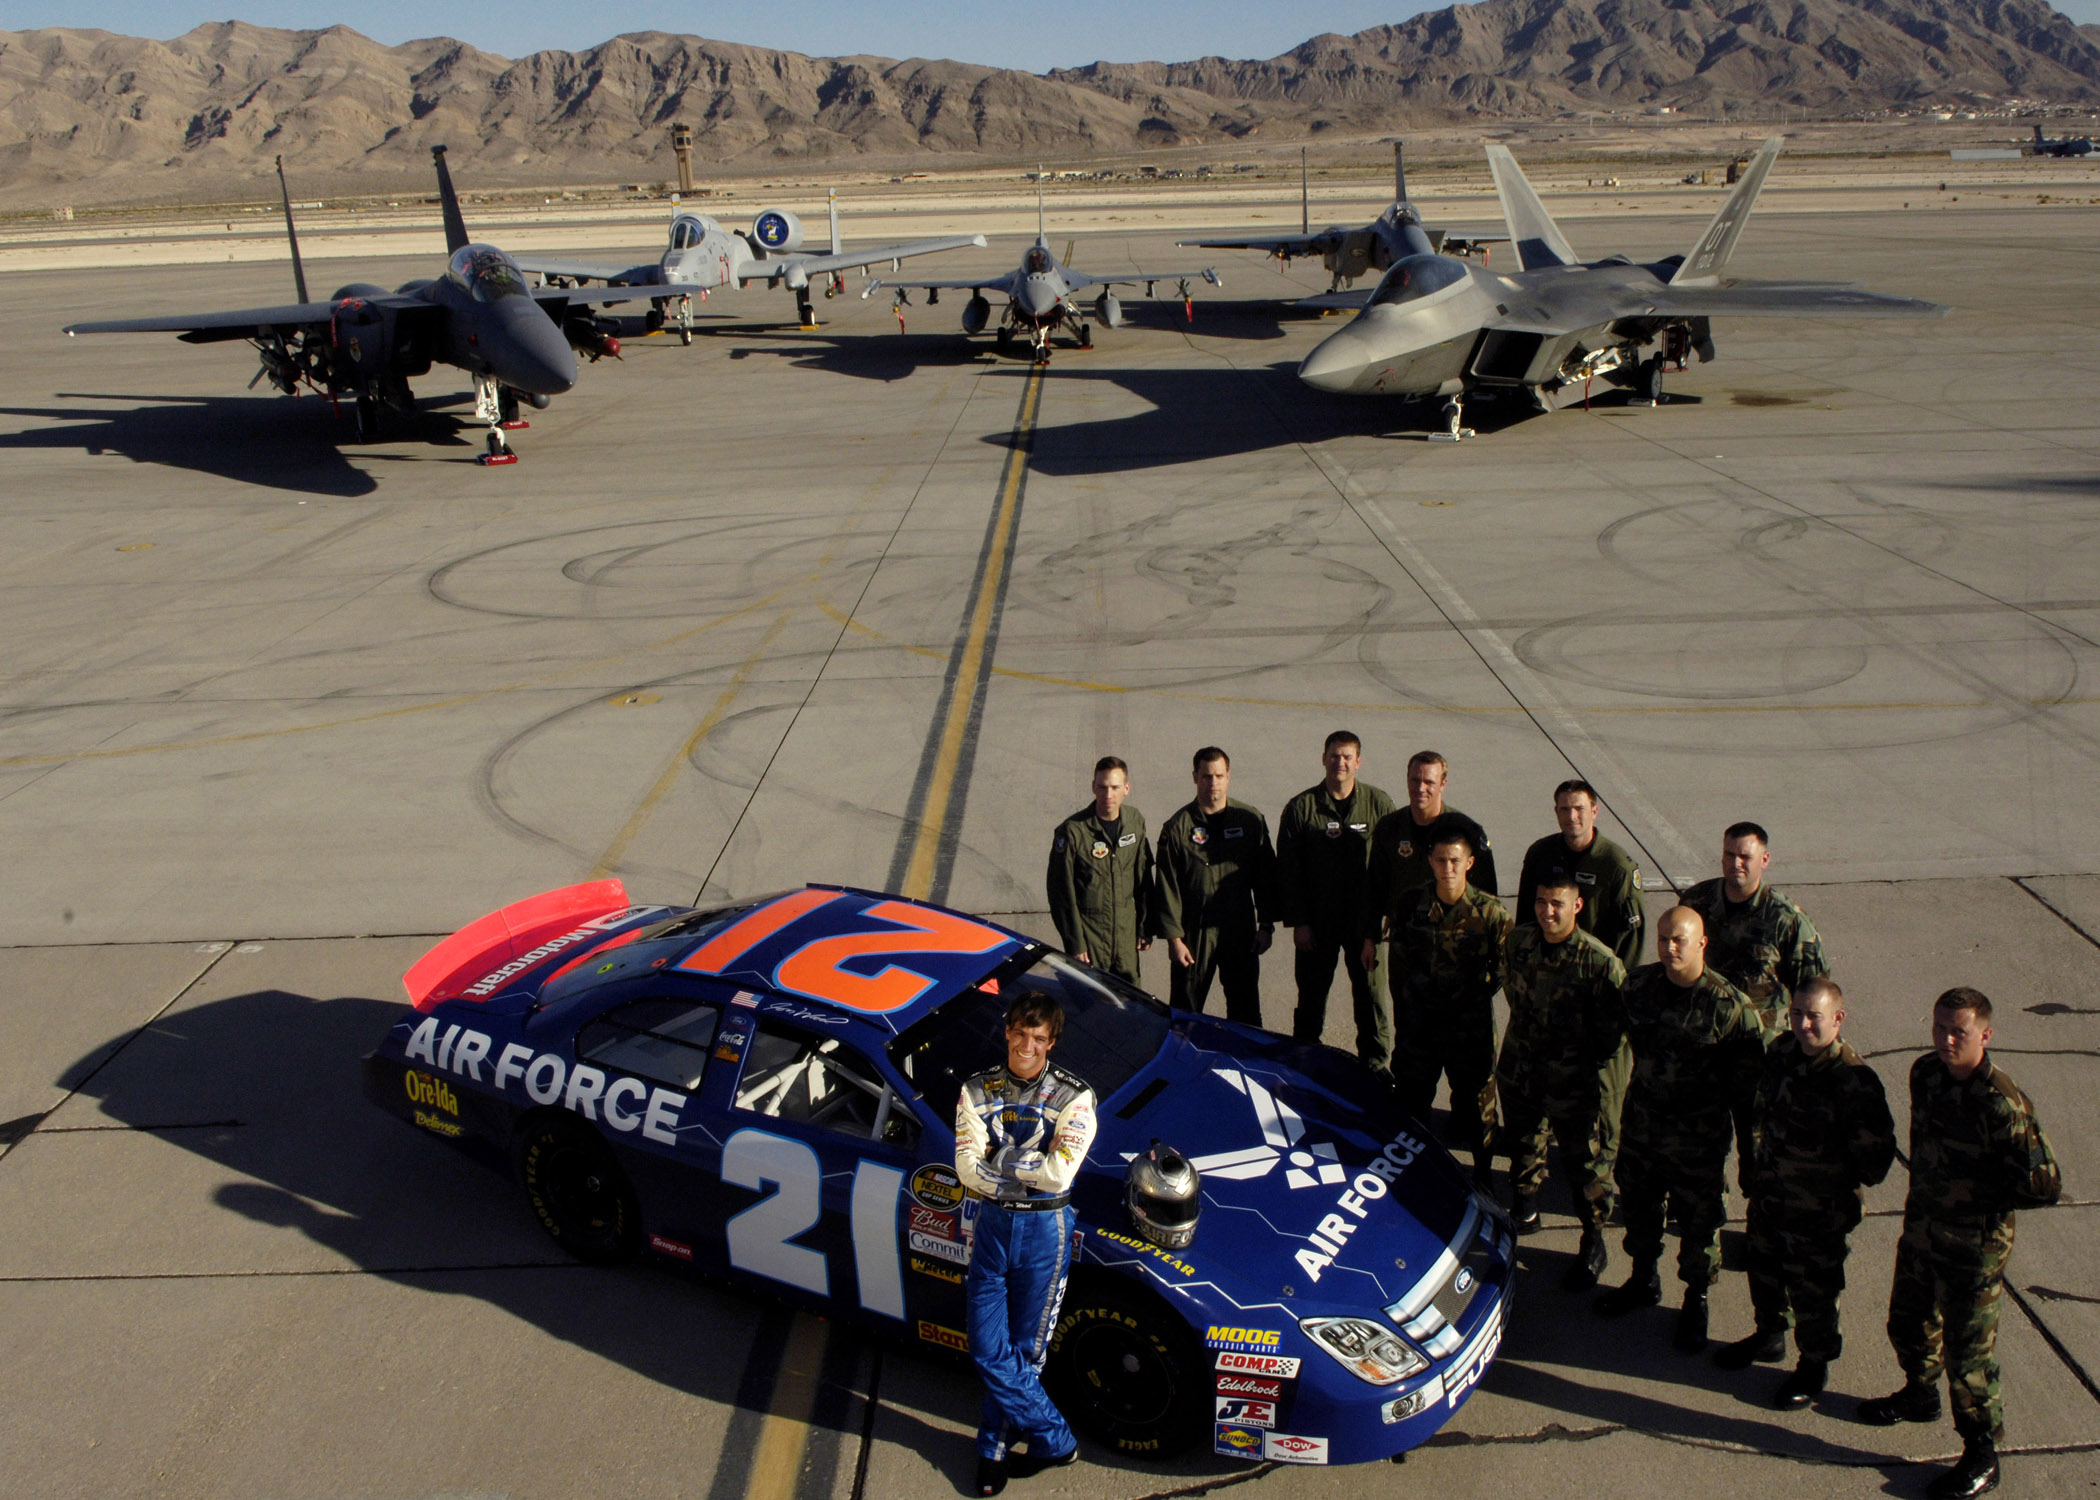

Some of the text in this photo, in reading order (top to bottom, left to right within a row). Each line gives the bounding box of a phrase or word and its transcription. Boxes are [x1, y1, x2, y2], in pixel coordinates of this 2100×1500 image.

[463, 927, 598, 996] Motorcraft
[673, 887, 1016, 1015] 21
[405, 1016, 688, 1146] AIR FORCE
[405, 1069, 459, 1117] Ore-Ida
[921, 1180, 953, 1198] NEXTEL
[934, 1173, 958, 1187] NASCAR
[932, 1194, 950, 1205] SERIES
[1294, 1131, 1427, 1283] AIR FORCE
[720, 1126, 908, 1322] 21
[911, 1206, 953, 1230] Bud
[911, 1231, 965, 1259] Commit
[1141, 1225, 1167, 1245] AIR
[651, 1236, 692, 1257] Snap-on
[1096, 1227, 1196, 1277] GOODYEAR
[1050, 1308, 1138, 1353] GOODYEAR
[1205, 1325, 1281, 1345] MOOG
[1208, 1340, 1277, 1354] CHASSIS PARTS
[1220, 1354, 1278, 1371] COMP
[1258, 1367, 1287, 1376] CAMS
[1217, 1377, 1279, 1397] Edelbrock
[1217, 1400, 1272, 1421] JE
[1234, 1417, 1274, 1428] PISTONS
[1219, 1432, 1260, 1446] SUNOCO
